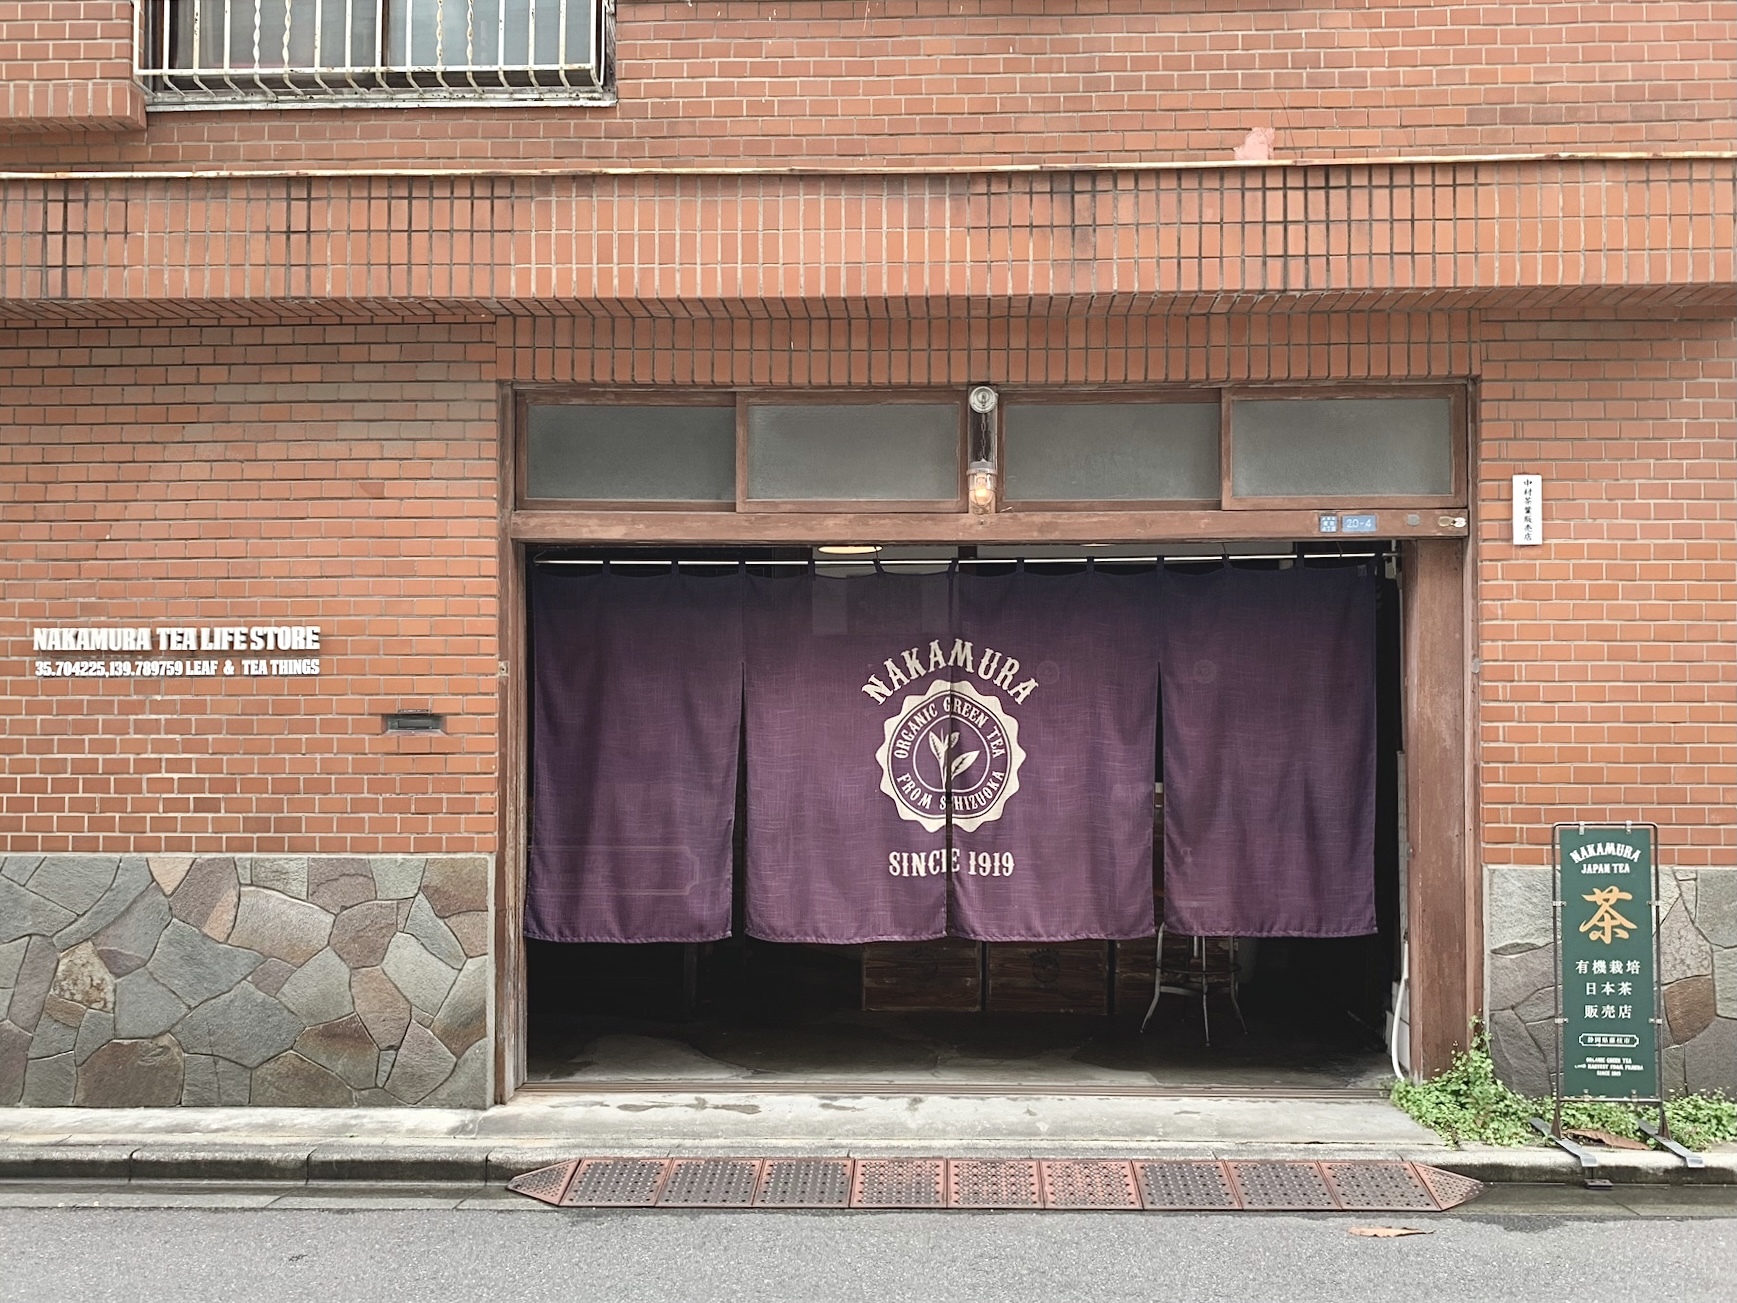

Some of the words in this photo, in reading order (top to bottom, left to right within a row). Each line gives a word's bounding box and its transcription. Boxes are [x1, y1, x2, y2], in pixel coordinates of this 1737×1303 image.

[1346, 518, 1371, 528] 20-4
[33, 627, 152, 651] NAKAMURA
[156, 627, 197, 651] TEA
[200, 627, 248, 650] LIFE
[250, 626, 320, 650] STORE
[35, 660, 183, 678] 35.704225,139.789759
[185, 660, 219, 676] LEAF
[223, 660, 235, 675] &
[242, 659, 268, 675] TEA
[270, 659, 320, 675] THINGS
[861, 638, 1039, 705] NAKAMURA
[894, 703, 938, 758] ORGANIC
[943, 696, 989, 729] GREEN
[986, 726, 1006, 758] TEA
[896, 772, 931, 810] FROM
[939, 769, 1005, 811] SHIZUOKA
[888, 848, 961, 877] SINCE
[968, 851, 1015, 877] 1919
[1569, 842, 1641, 864] NAKAMURA
[1581, 863, 1610, 874] JAPAN
[1612, 863, 1630, 874] TEA
[1579, 885, 1638, 944] 茶
[1575, 959, 1641, 975] 有機栽培
[1586, 981, 1633, 996] 日本茶
[1584, 1004, 1633, 1019] 販売店
